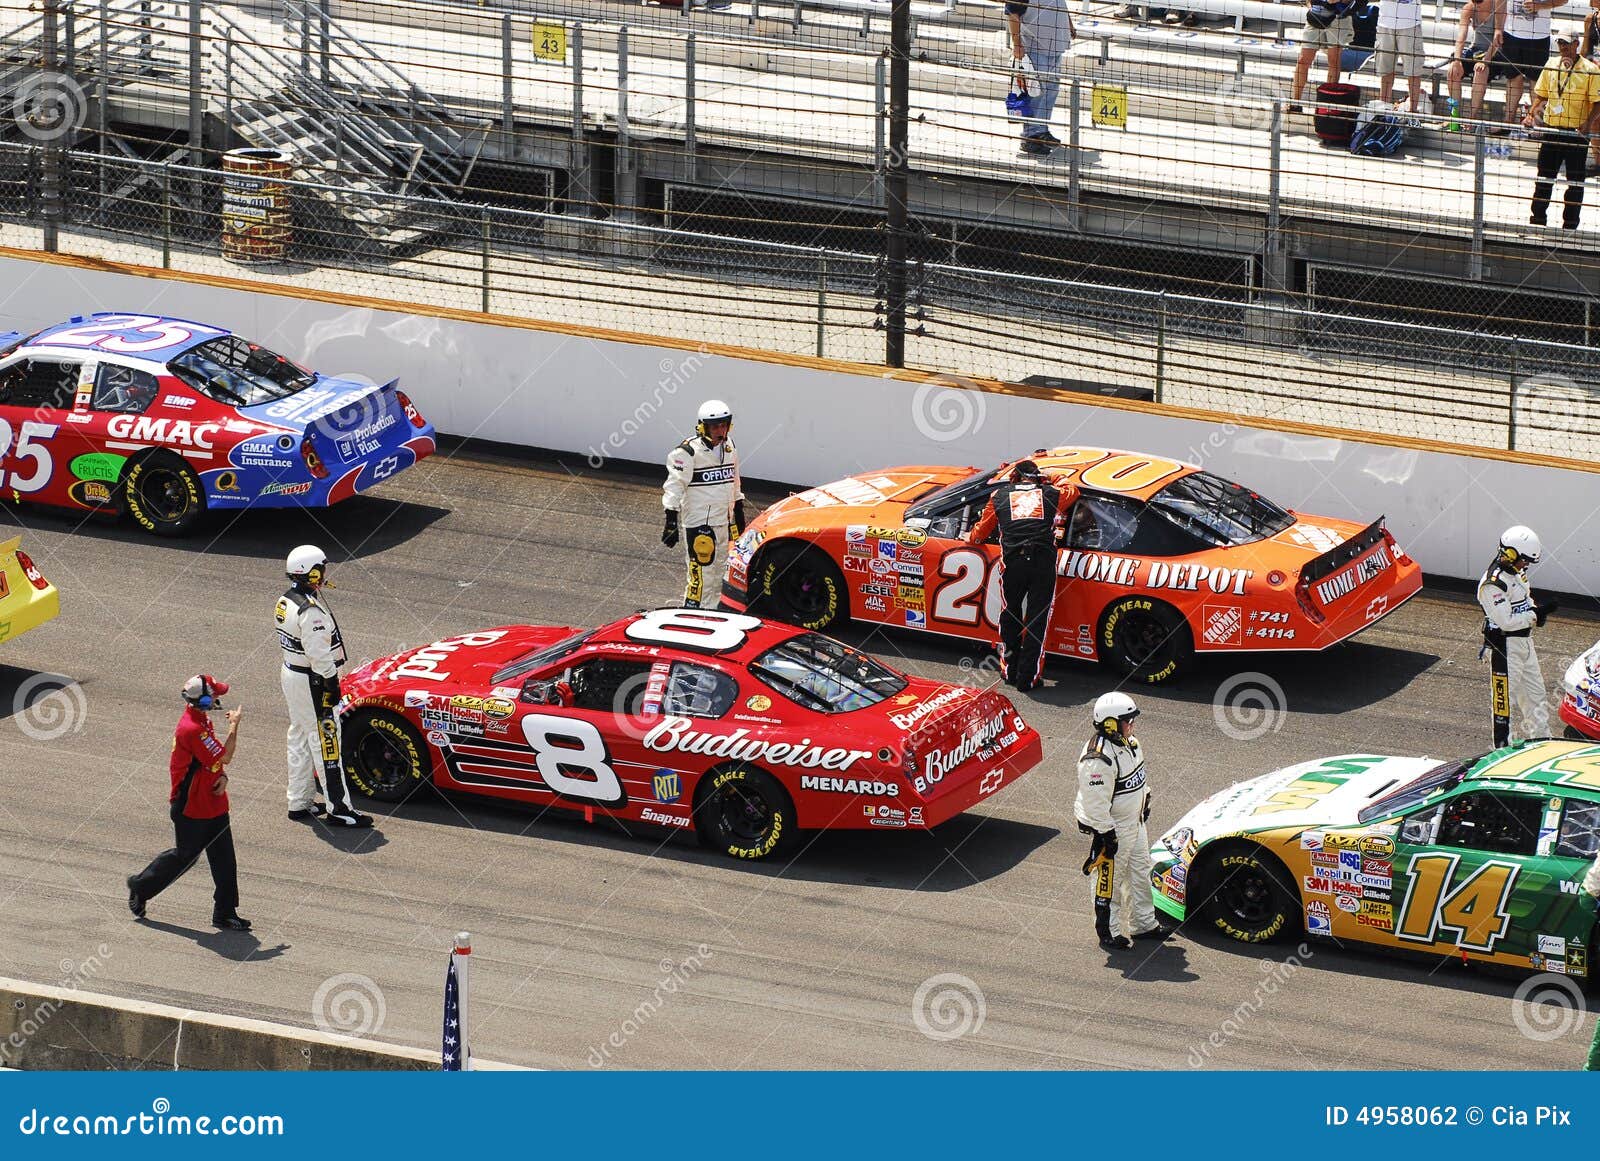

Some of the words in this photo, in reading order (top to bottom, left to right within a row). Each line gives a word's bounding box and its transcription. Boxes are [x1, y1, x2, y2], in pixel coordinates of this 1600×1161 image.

[541, 39, 559, 53] 43
[1100, 105, 1119, 119] 44
[33, 314, 231, 352] 25
[163, 394, 197, 407] EMP
[405, 403, 417, 420] 25
[107, 414, 220, 449] GMAC
[355, 413, 395, 442] Protection
[241, 443, 274, 454] GMAC
[341, 440, 353, 454] GM
[357, 438, 381, 456] Plan
[241, 455, 292, 468] Insurance
[78, 463, 114, 478] FRUCTIS
[179, 470, 198, 504] EAGLE
[126, 463, 155, 530] GOODYEAR
[879, 541, 896, 559] USG
[900, 549, 923, 560] Bud
[844, 556, 867, 572] 3M
[872, 560, 886, 568] EA
[891, 561, 923, 573] Commit
[1057, 549, 1141, 587] HOME
[1146, 561, 1254, 596] DEPOT
[763, 563, 776, 596] EAGLE
[1316, 569, 1357, 605] HOME
[1356, 547, 1392, 585] DEPOT
[859, 584, 894, 597] JESEL
[803, 576, 838, 630] GOODYEAR
[864, 595, 886, 608] MAC
[895, 598, 925, 611] Stant
[1104, 600, 1153, 649] GOODYEAR
[1204, 607, 1242, 643] HOME
[1208, 610, 1223, 625] THE
[624, 607, 764, 656] 8
[1218, 621, 1242, 645] DEPOT
[1149, 660, 1176, 683] EAGLE
[425, 696, 452, 712] 3M
[889, 687, 967, 731] Budweiser
[453, 707, 481, 722] Holley
[424, 719, 448, 730] Mobil
[1013, 716, 1026, 732] 8
[432, 732, 444, 740] EA
[642, 712, 873, 772] Budweiser
[370, 718, 421, 779] GOODYEAR
[925, 708, 1008, 784] Budweiser
[976, 750, 995, 763] THIS
[1000, 731, 1020, 748] BEER
[520, 713, 628, 809] 8
[653, 772, 681, 802] RITZ
[713, 770, 746, 788] EAGLE
[801, 775, 899, 797] MENARDS
[914, 776, 927, 793] 8
[640, 807, 690, 828] Snap-on
[727, 811, 783, 859] GOODYEAR
[1221, 856, 1260, 868] EAGLE
[1340, 851, 1361, 871] USG
[1365, 860, 1391, 872] Bud
[1100, 861, 1110, 893] NEXTEL
[1315, 867, 1341, 878] Mobil
[1354, 874, 1391, 888] Commit
[1306, 877, 1329, 892] 3M
[1331, 881, 1362, 895] Holley
[1340, 896, 1356, 906] EA
[1363, 889, 1391, 900] Gillette
[1396, 852, 1522, 952] 14
[1306, 901, 1330, 914] MAC
[1215, 914, 1285, 943] GOODYEAR
[1357, 914, 1392, 929] Stant
